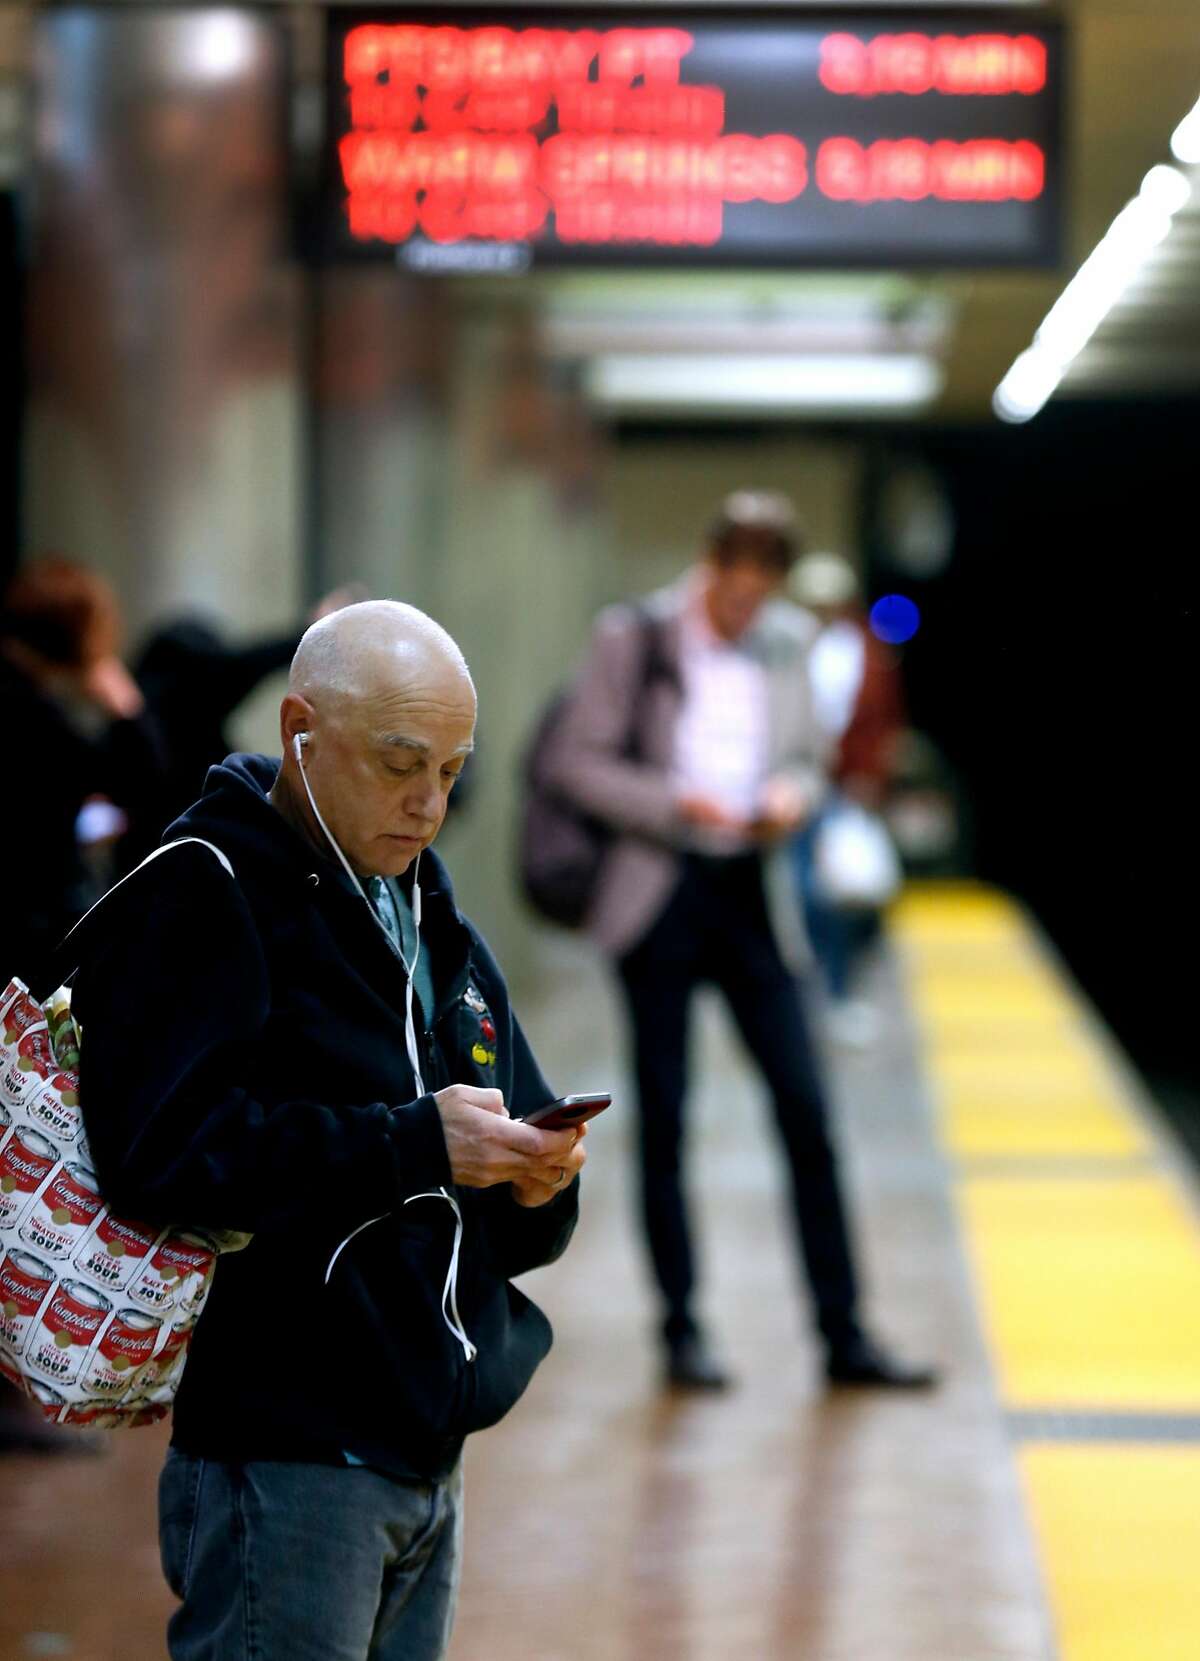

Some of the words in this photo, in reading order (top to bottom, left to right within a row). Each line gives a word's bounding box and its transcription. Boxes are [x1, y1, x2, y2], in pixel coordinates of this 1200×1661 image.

[38, 1105, 70, 1129] SOUP
[43, 1093, 65, 1115] GREEN
[64, 1111, 80, 1124] PEA
[29, 1216, 56, 1239] TOMATO
[29, 1230, 63, 1252] SOUP
[86, 1259, 120, 1281] SOUP
[139, 1287, 166, 1301] SOU
[37, 1353, 69, 1374] SOUP
[40, 1345, 71, 1366] CHICKEN
